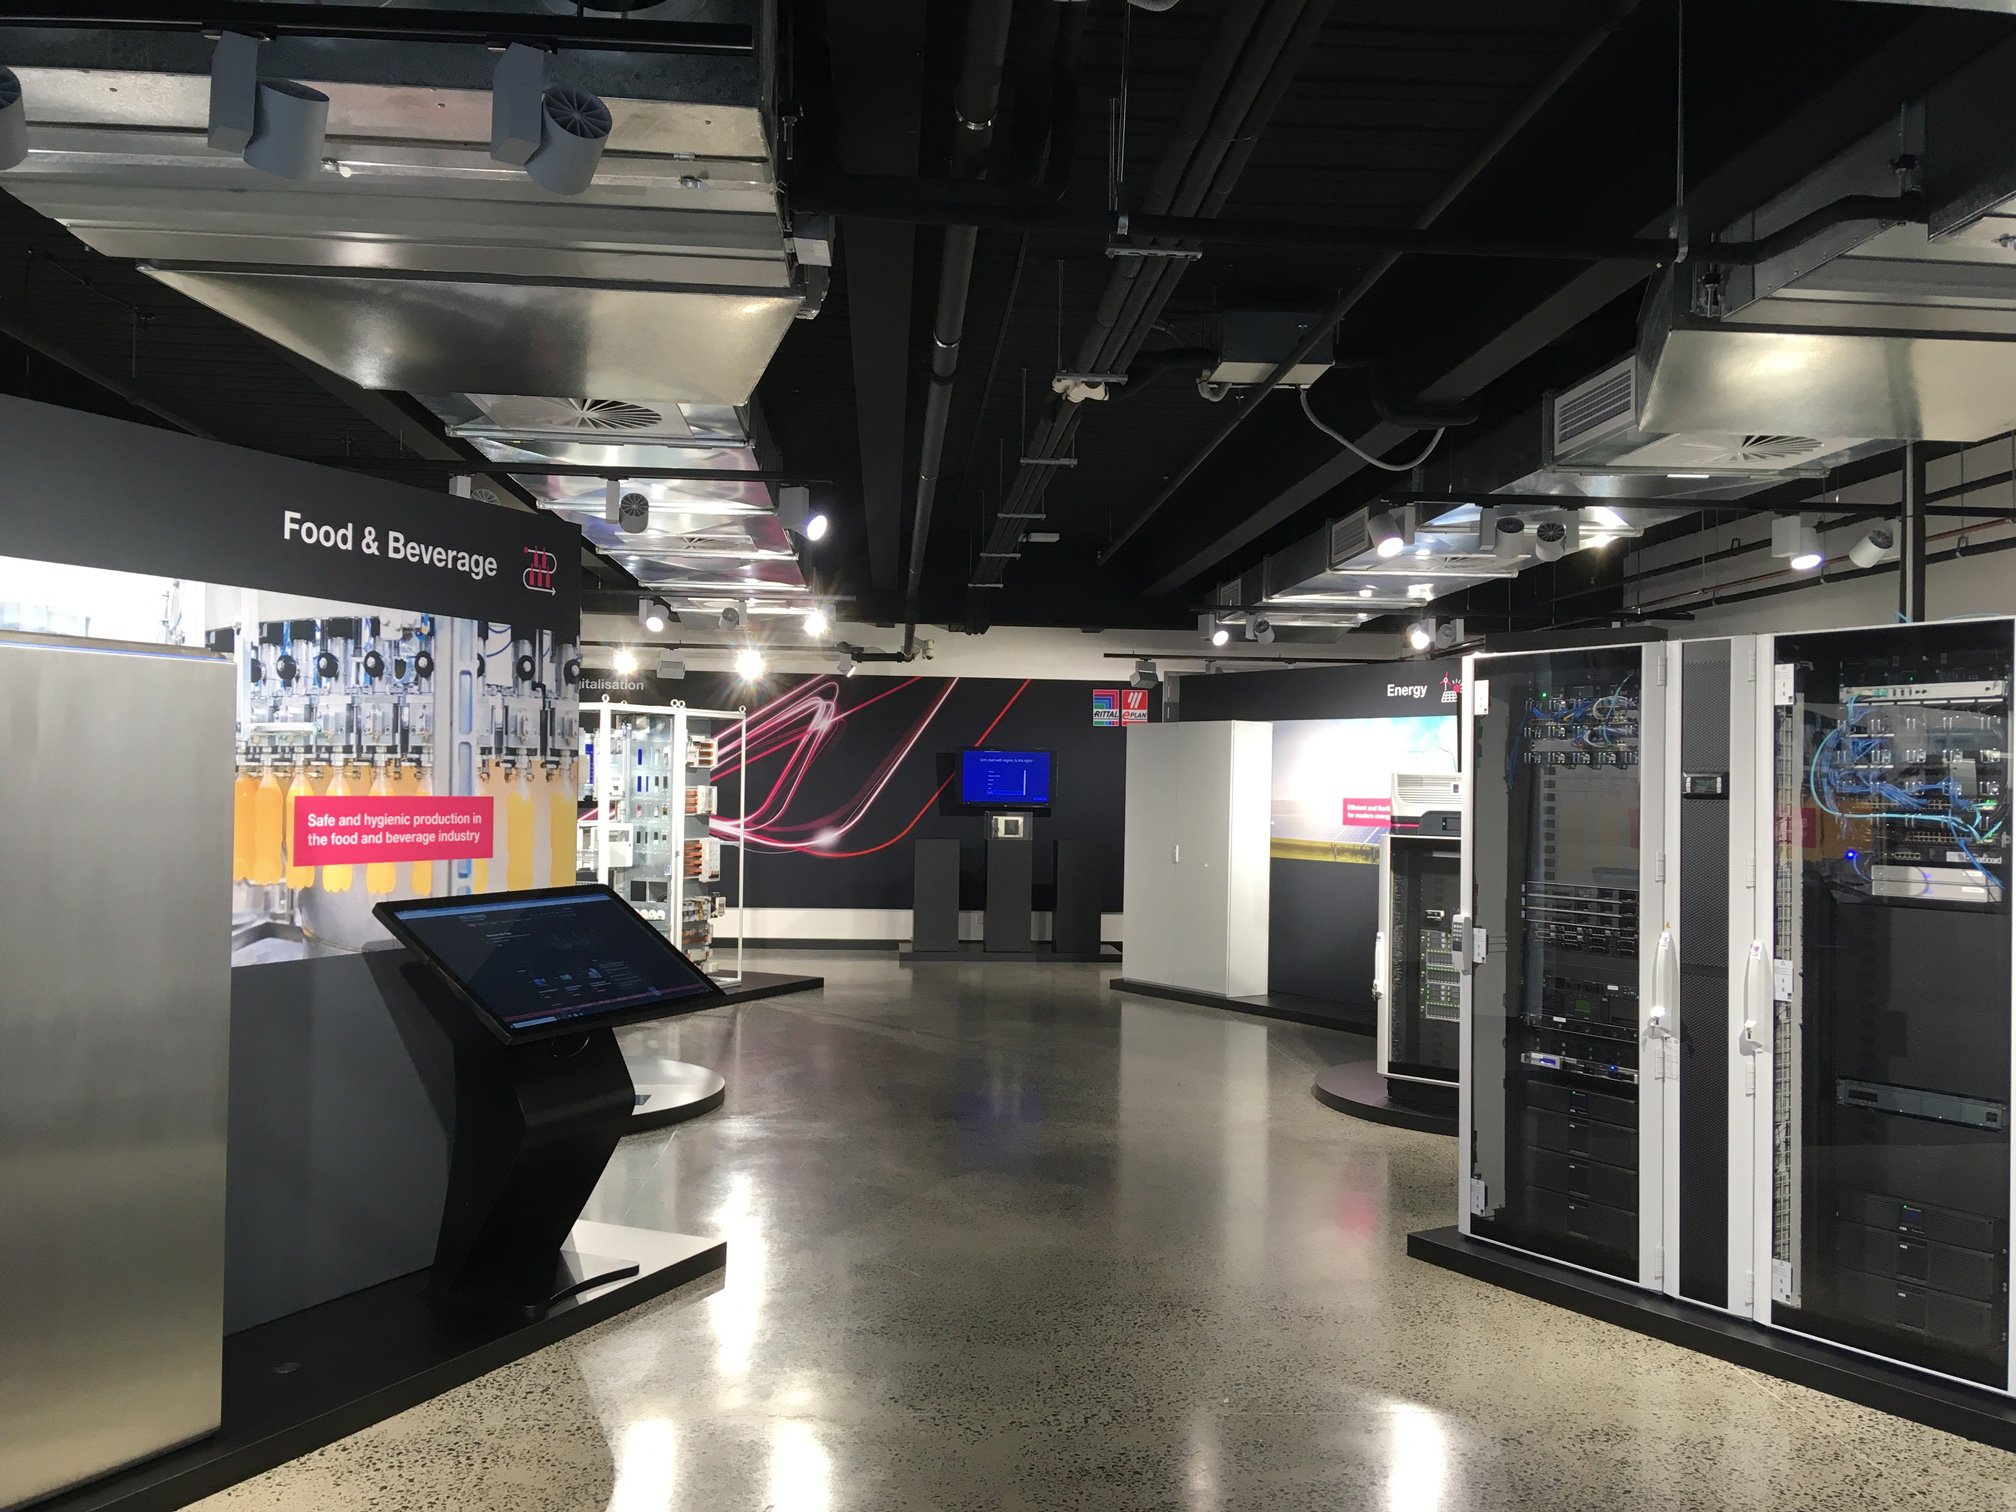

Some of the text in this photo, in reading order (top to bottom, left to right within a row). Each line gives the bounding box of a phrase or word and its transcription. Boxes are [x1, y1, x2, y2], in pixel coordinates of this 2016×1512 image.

[284, 510, 498, 580] Food & Beverage
[1387, 683, 1428, 699] Energy
[1094, 710, 1119, 718] RITTAL
[307, 812, 482, 828] Safe and hygienic production in
[307, 830, 480, 846] the food and beverage industry
